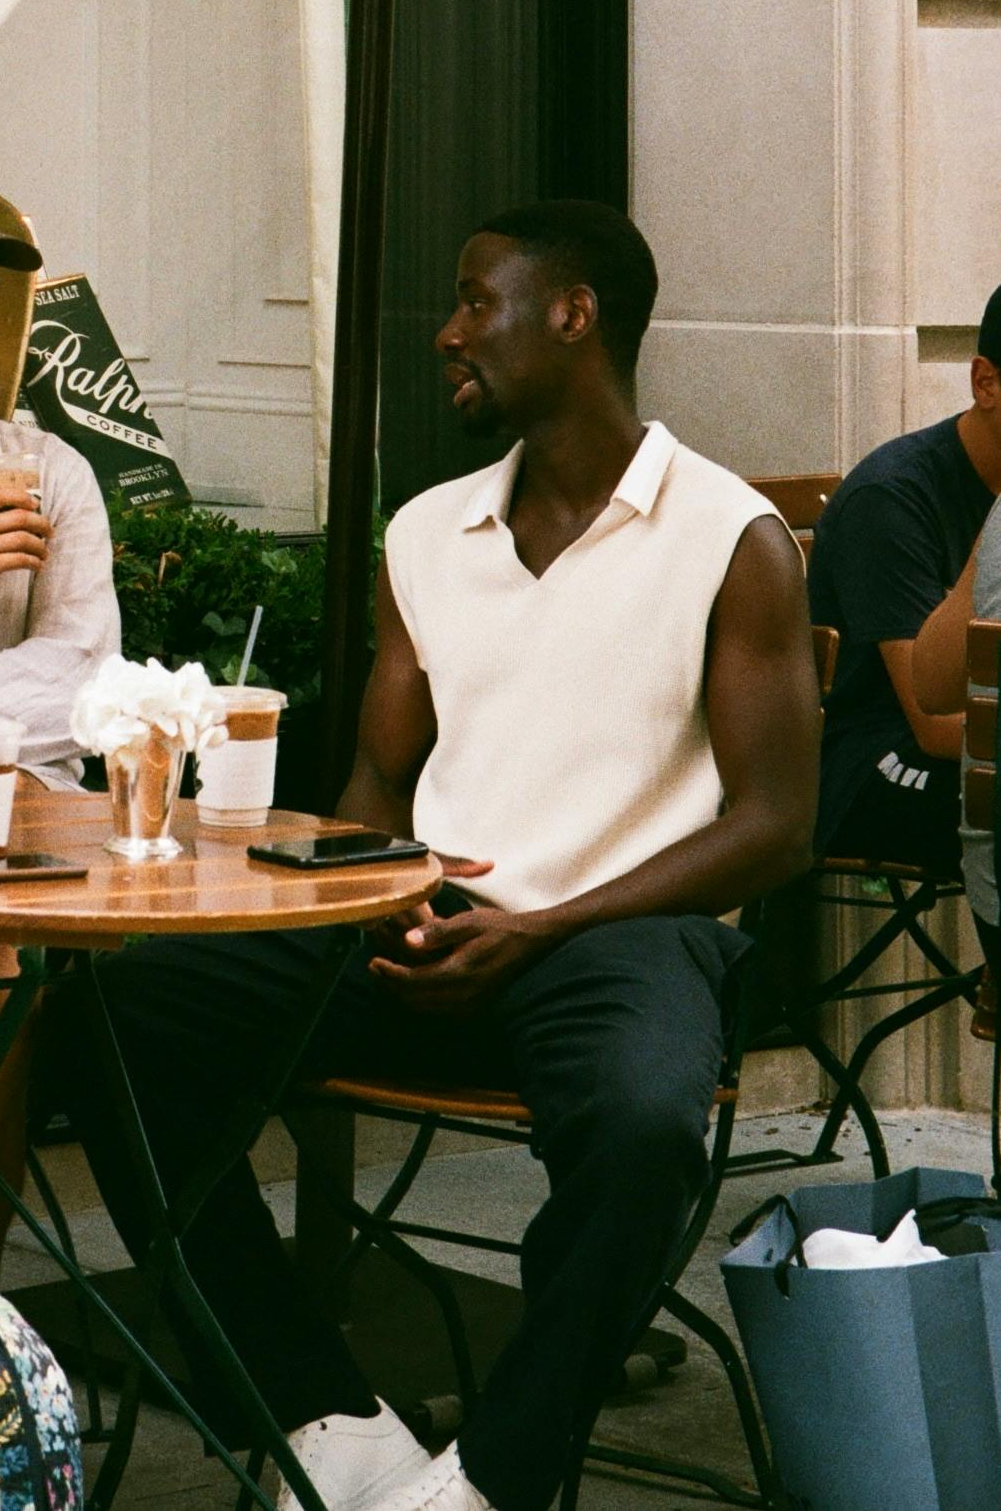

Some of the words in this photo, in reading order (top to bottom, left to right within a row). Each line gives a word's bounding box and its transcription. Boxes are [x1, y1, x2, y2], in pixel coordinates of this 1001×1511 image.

[34, 289, 56, 306] SEA
[56, 284, 81, 301] SALT
[87, 414, 157, 450] COFFEE
